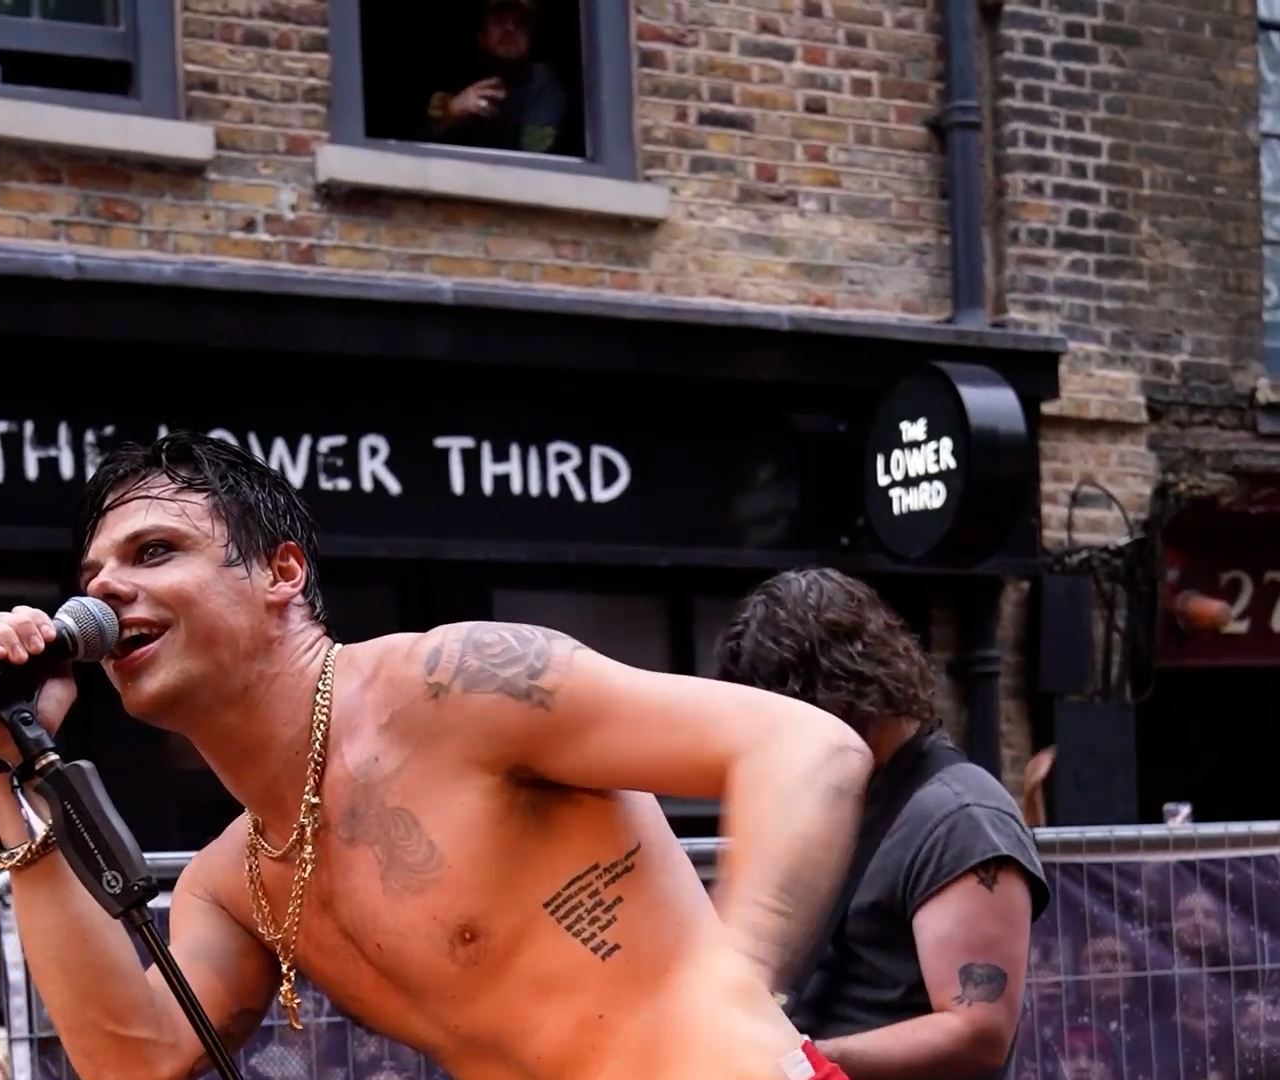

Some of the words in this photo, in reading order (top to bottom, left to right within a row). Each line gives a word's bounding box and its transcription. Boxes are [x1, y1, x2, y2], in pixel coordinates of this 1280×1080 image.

[899, 417, 928, 443] THE
[433, 436, 631, 503] THIRD
[876, 436, 957, 487] LOWER
[888, 480, 947, 516] THIRD
